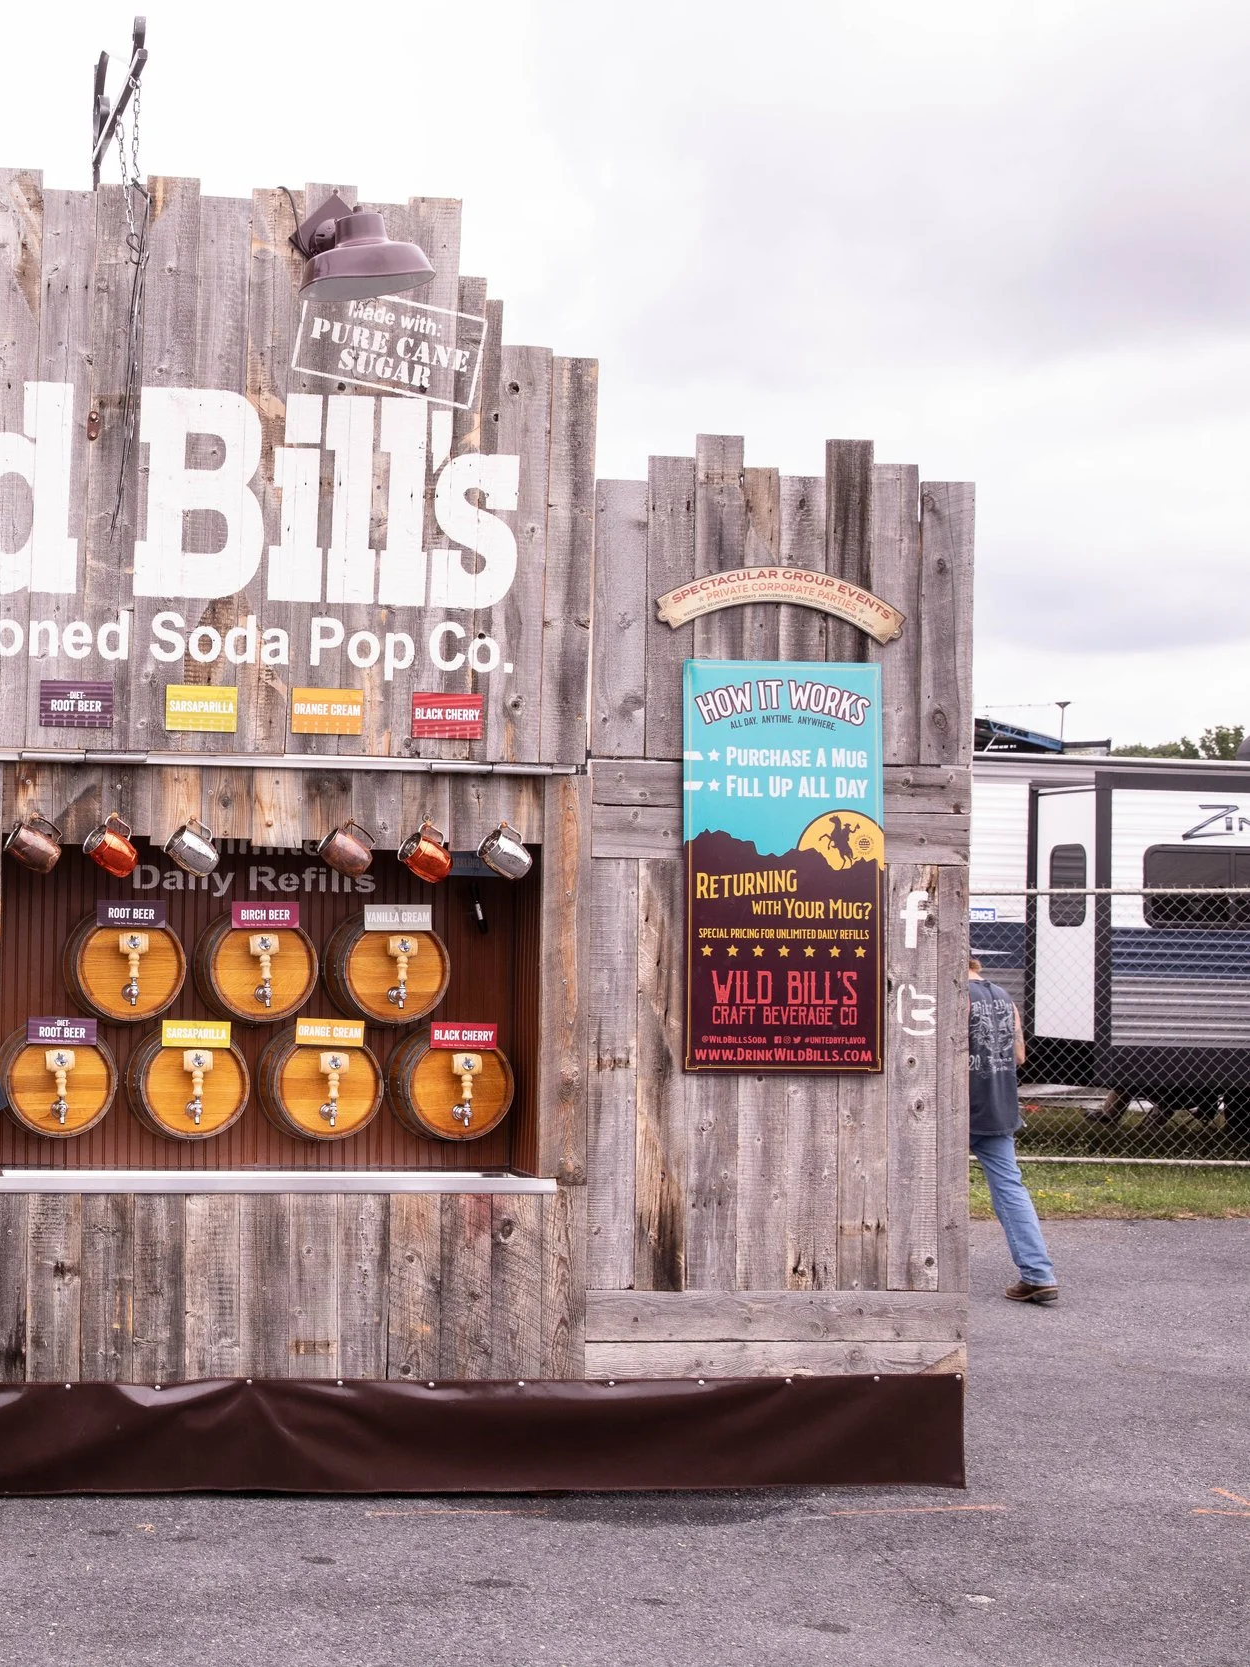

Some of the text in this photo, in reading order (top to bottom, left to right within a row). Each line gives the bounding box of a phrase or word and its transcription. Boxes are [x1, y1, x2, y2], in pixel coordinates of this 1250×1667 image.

[348, 300, 443, 338] Made with:
[310, 317, 471, 373] PURE CANE
[338, 348, 431, 388] SUGAR
[132, 386, 520, 609] Bill's
[672, 570, 892, 620] SPECTACULAR GROUP EVENTS
[706, 582, 858, 612] PRIVATE CORPORATE PARTIES
[150, 611, 290, 666] Soda
[310, 616, 416, 681] Pop
[428, 620, 514, 674] Co.
[50, 699, 102, 713] ROOT BEER
[168, 699, 234, 715] SARSAPARILLA
[293, 702, 361, 718] ORANGE CREAM
[694, 679, 871, 727] HOW IT WORKS
[414, 706, 480, 723] BLACK CHERRY
[730, 715, 837, 732] ALL DAY. ANYTIME. ANYWHERE.
[816, 748, 826, 767] A
[798, 776, 830, 799] ALL
[250, 866, 376, 893] Refills
[108, 907, 154, 919] ROOT BEER
[240, 909, 290, 920] BIRCH BEER
[366, 911, 430, 922] VANILLA CREAM
[969, 908, 995, 920] ENCE
[698, 927, 869, 940] SPECIAL PRICING FOR UNLIMITED DAILY REFILLS
[711, 970, 858, 1005] WILD BILL'S
[712, 1006, 857, 1026] CRAFT BEVERAGE CO
[39, 1026, 86, 1039] ROOT BEER
[165, 1027, 227, 1040] SARSAPARILLA
[298, 1025, 362, 1039] ORANGE CREAM
[434, 1029, 494, 1042] BLACK CHERRY
